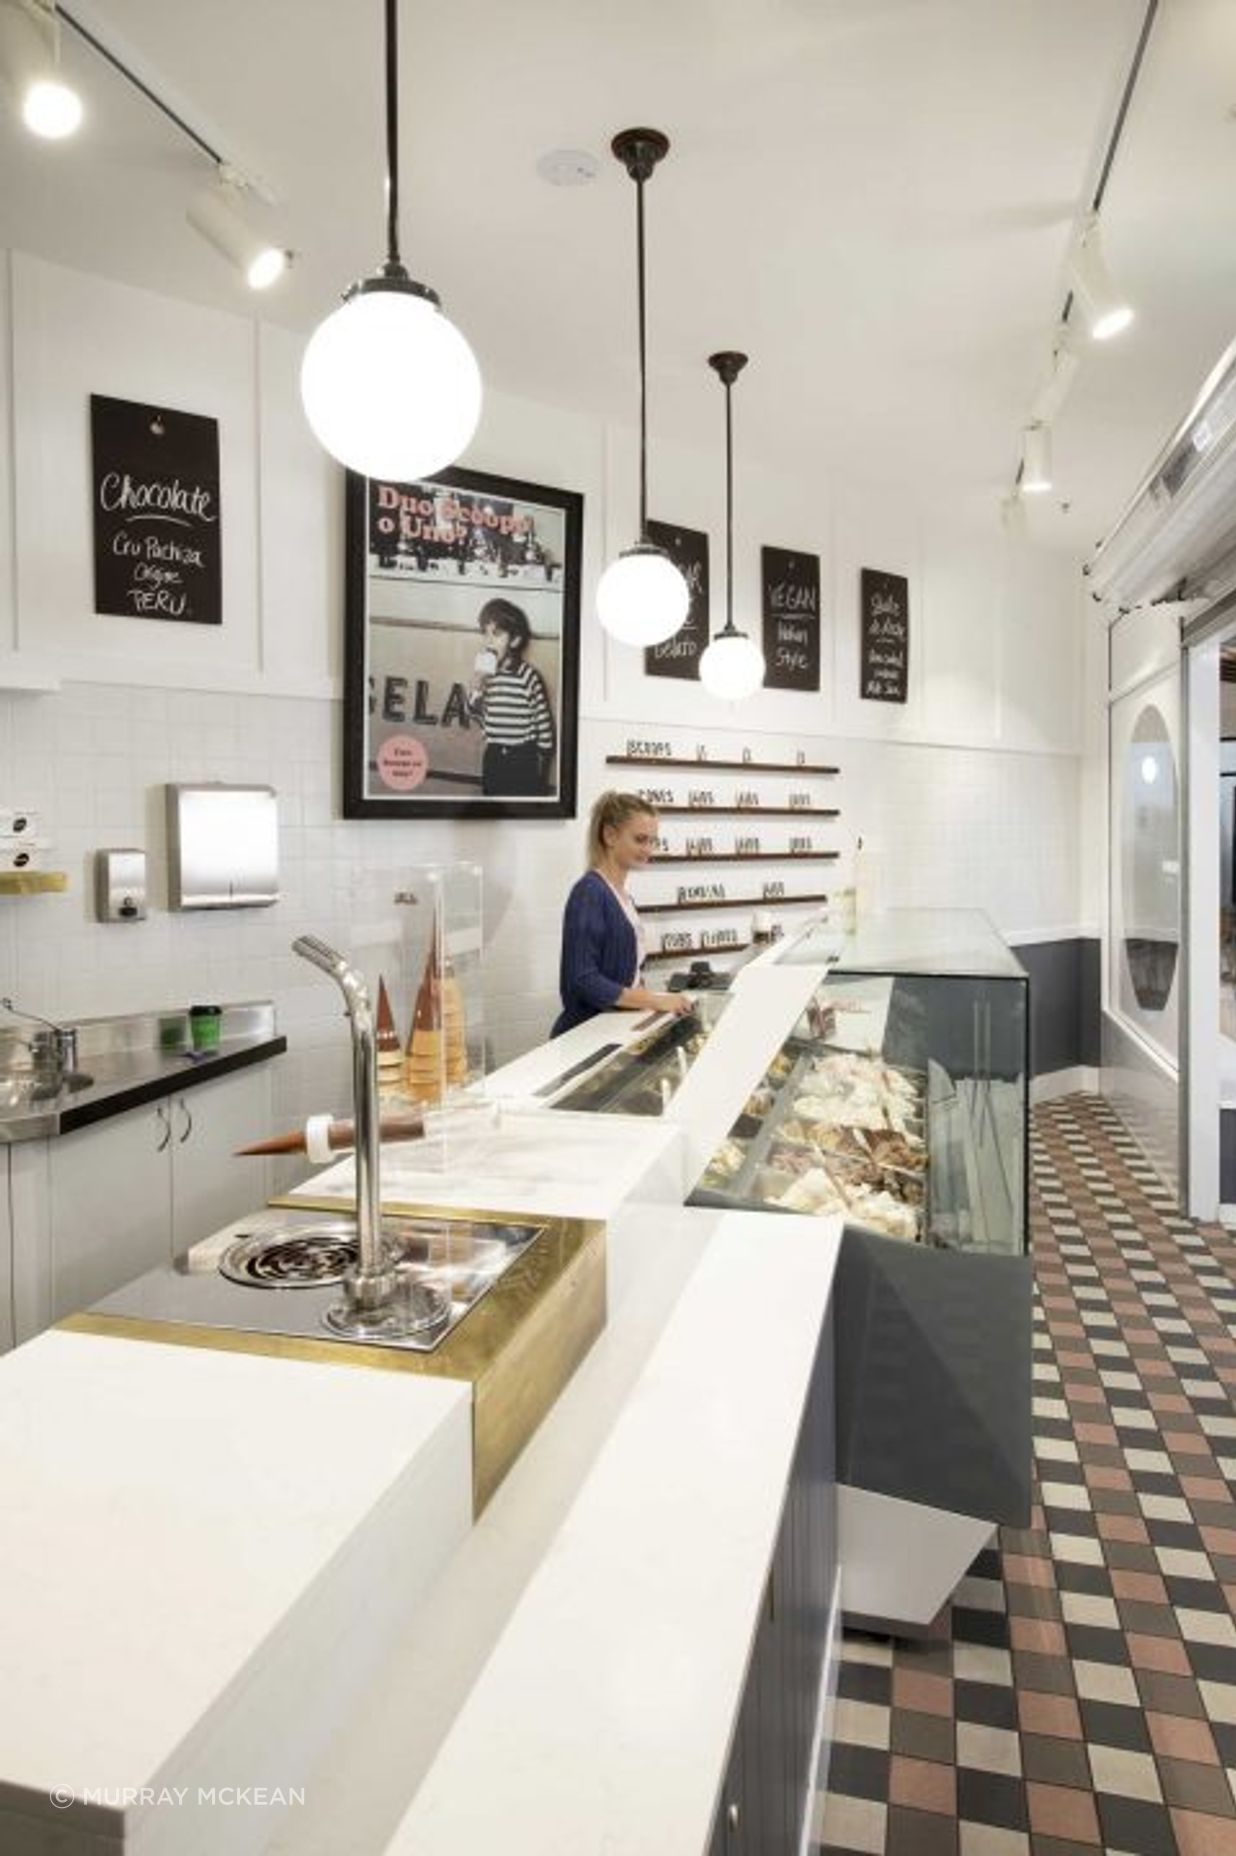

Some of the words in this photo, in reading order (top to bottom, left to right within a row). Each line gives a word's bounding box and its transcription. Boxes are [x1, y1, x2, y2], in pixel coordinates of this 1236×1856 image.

[100, 472, 216, 521] Chocolate
[378, 486, 432, 515] Duo
[127, 589, 187, 616] PERU
[768, 583, 817, 612] VEGAN
[369, 676, 470, 729] ELA
